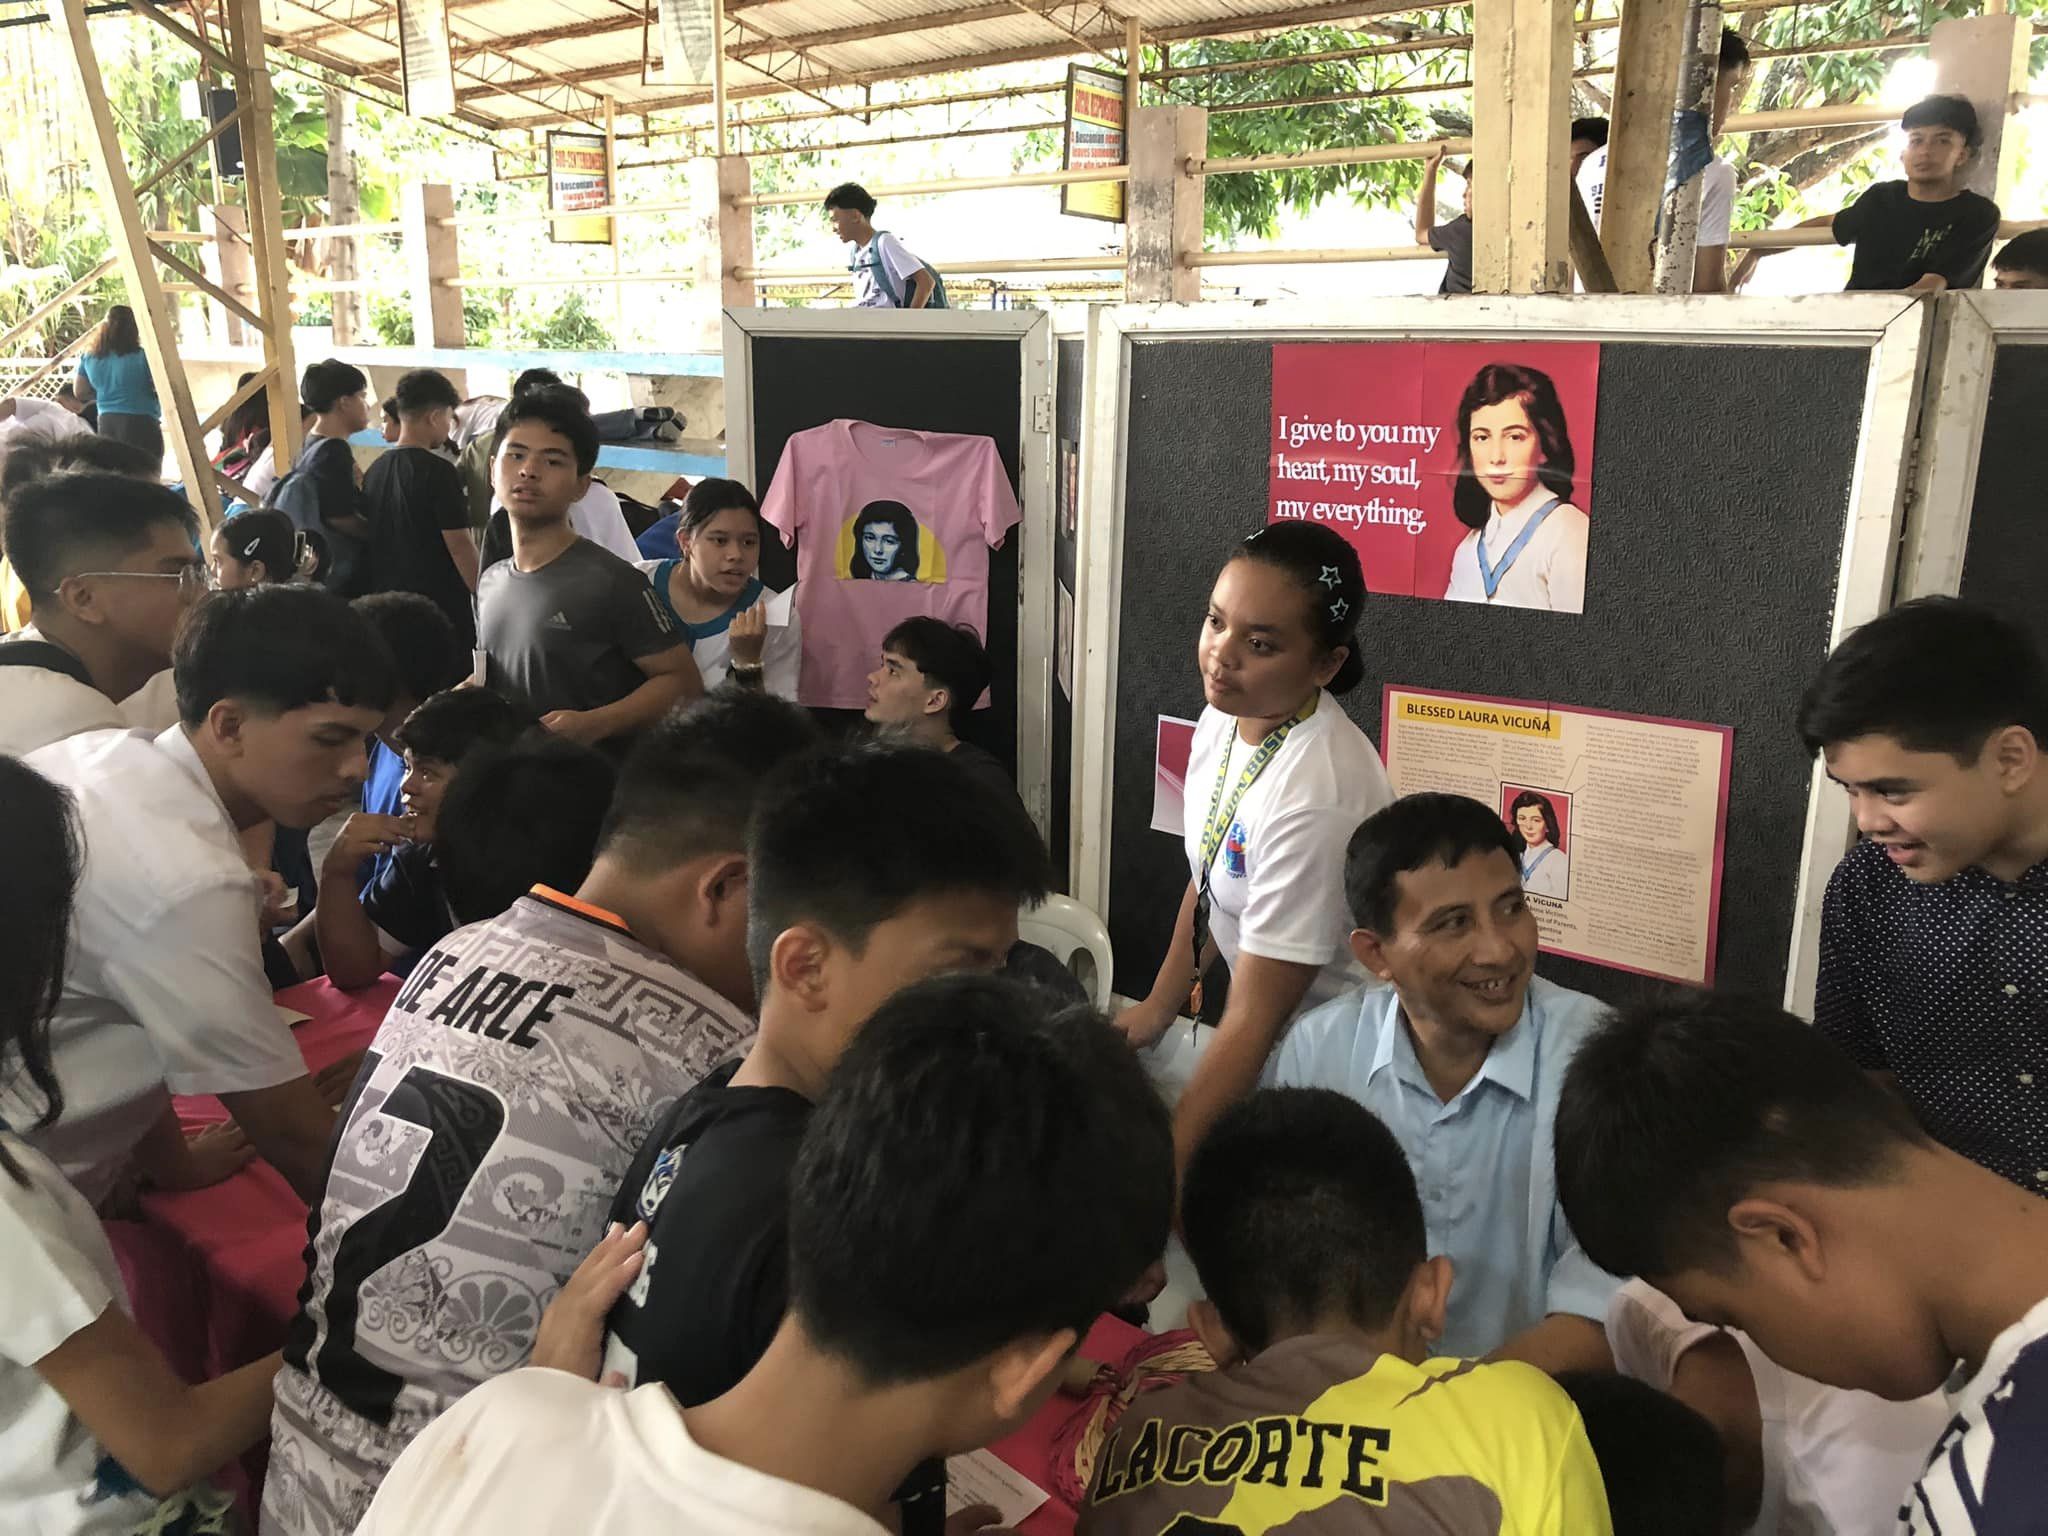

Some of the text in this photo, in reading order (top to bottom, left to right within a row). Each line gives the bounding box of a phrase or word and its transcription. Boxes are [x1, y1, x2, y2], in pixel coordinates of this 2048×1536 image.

[1279, 414, 1441, 453] I give to you my
[1277, 453, 1421, 491] heart, my soul,
[1275, 499, 1311, 521] my
[1407, 703, 1551, 731] BLESSED LAURA VICUÑA
[395, 949, 576, 1049] DE ARCE
[1094, 1416, 1391, 1503] LACORTE
